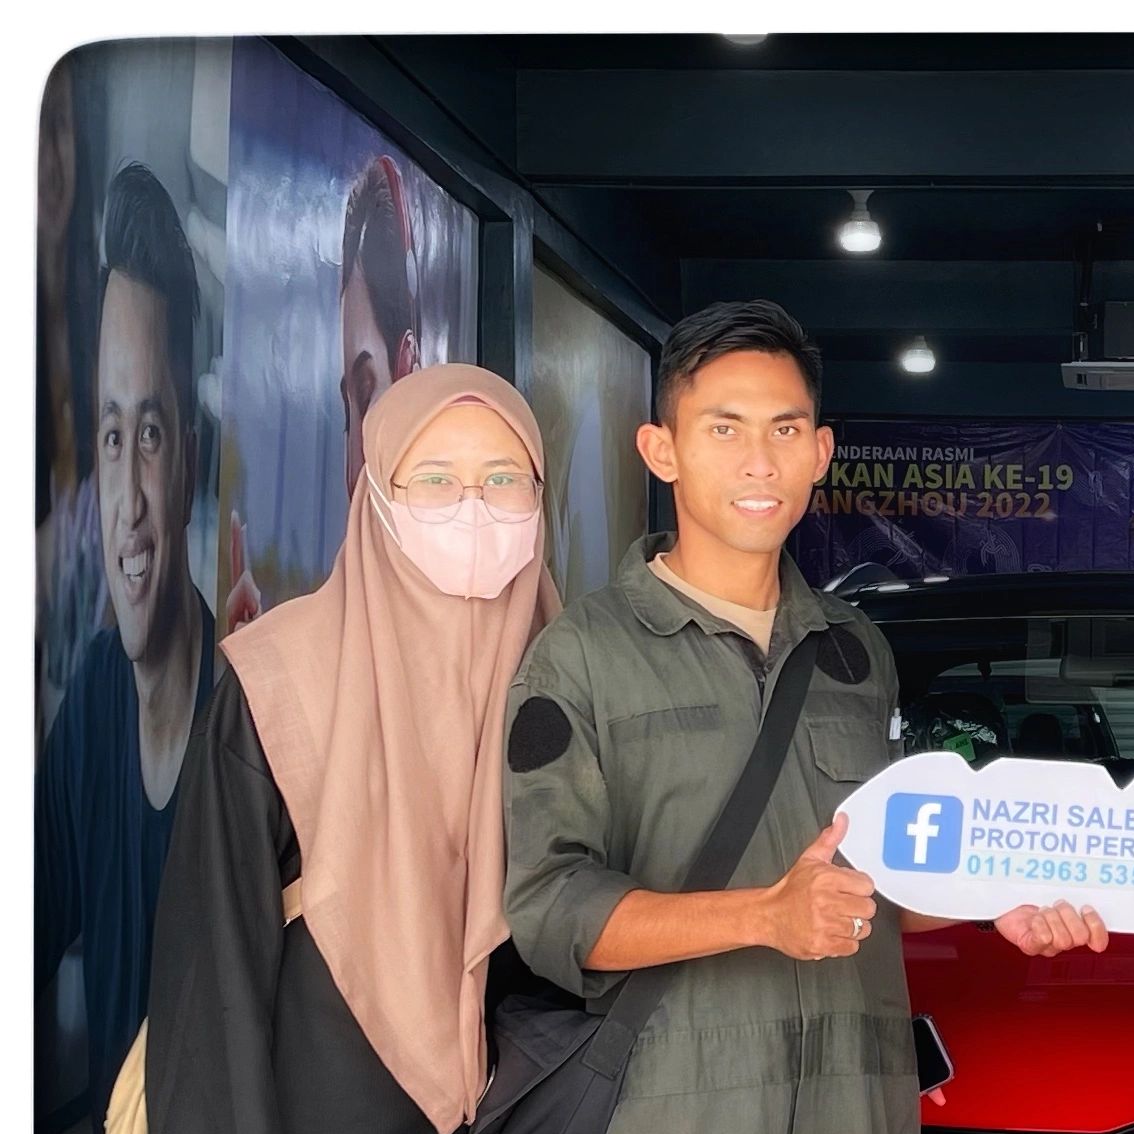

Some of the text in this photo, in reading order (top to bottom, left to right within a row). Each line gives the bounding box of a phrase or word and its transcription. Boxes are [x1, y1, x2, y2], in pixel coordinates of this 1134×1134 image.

[832, 445, 974, 462] NDERAAN RASMI
[902, 463, 976, 489] ASIA
[984, 464, 1073, 490] KE-19
[808, 489, 1051, 518] ANGZHOU 2022
[972, 798, 1058, 826] NAZRI
[970, 827, 1077, 853] PROTON
[967, 854, 1088, 882] 011-2963
